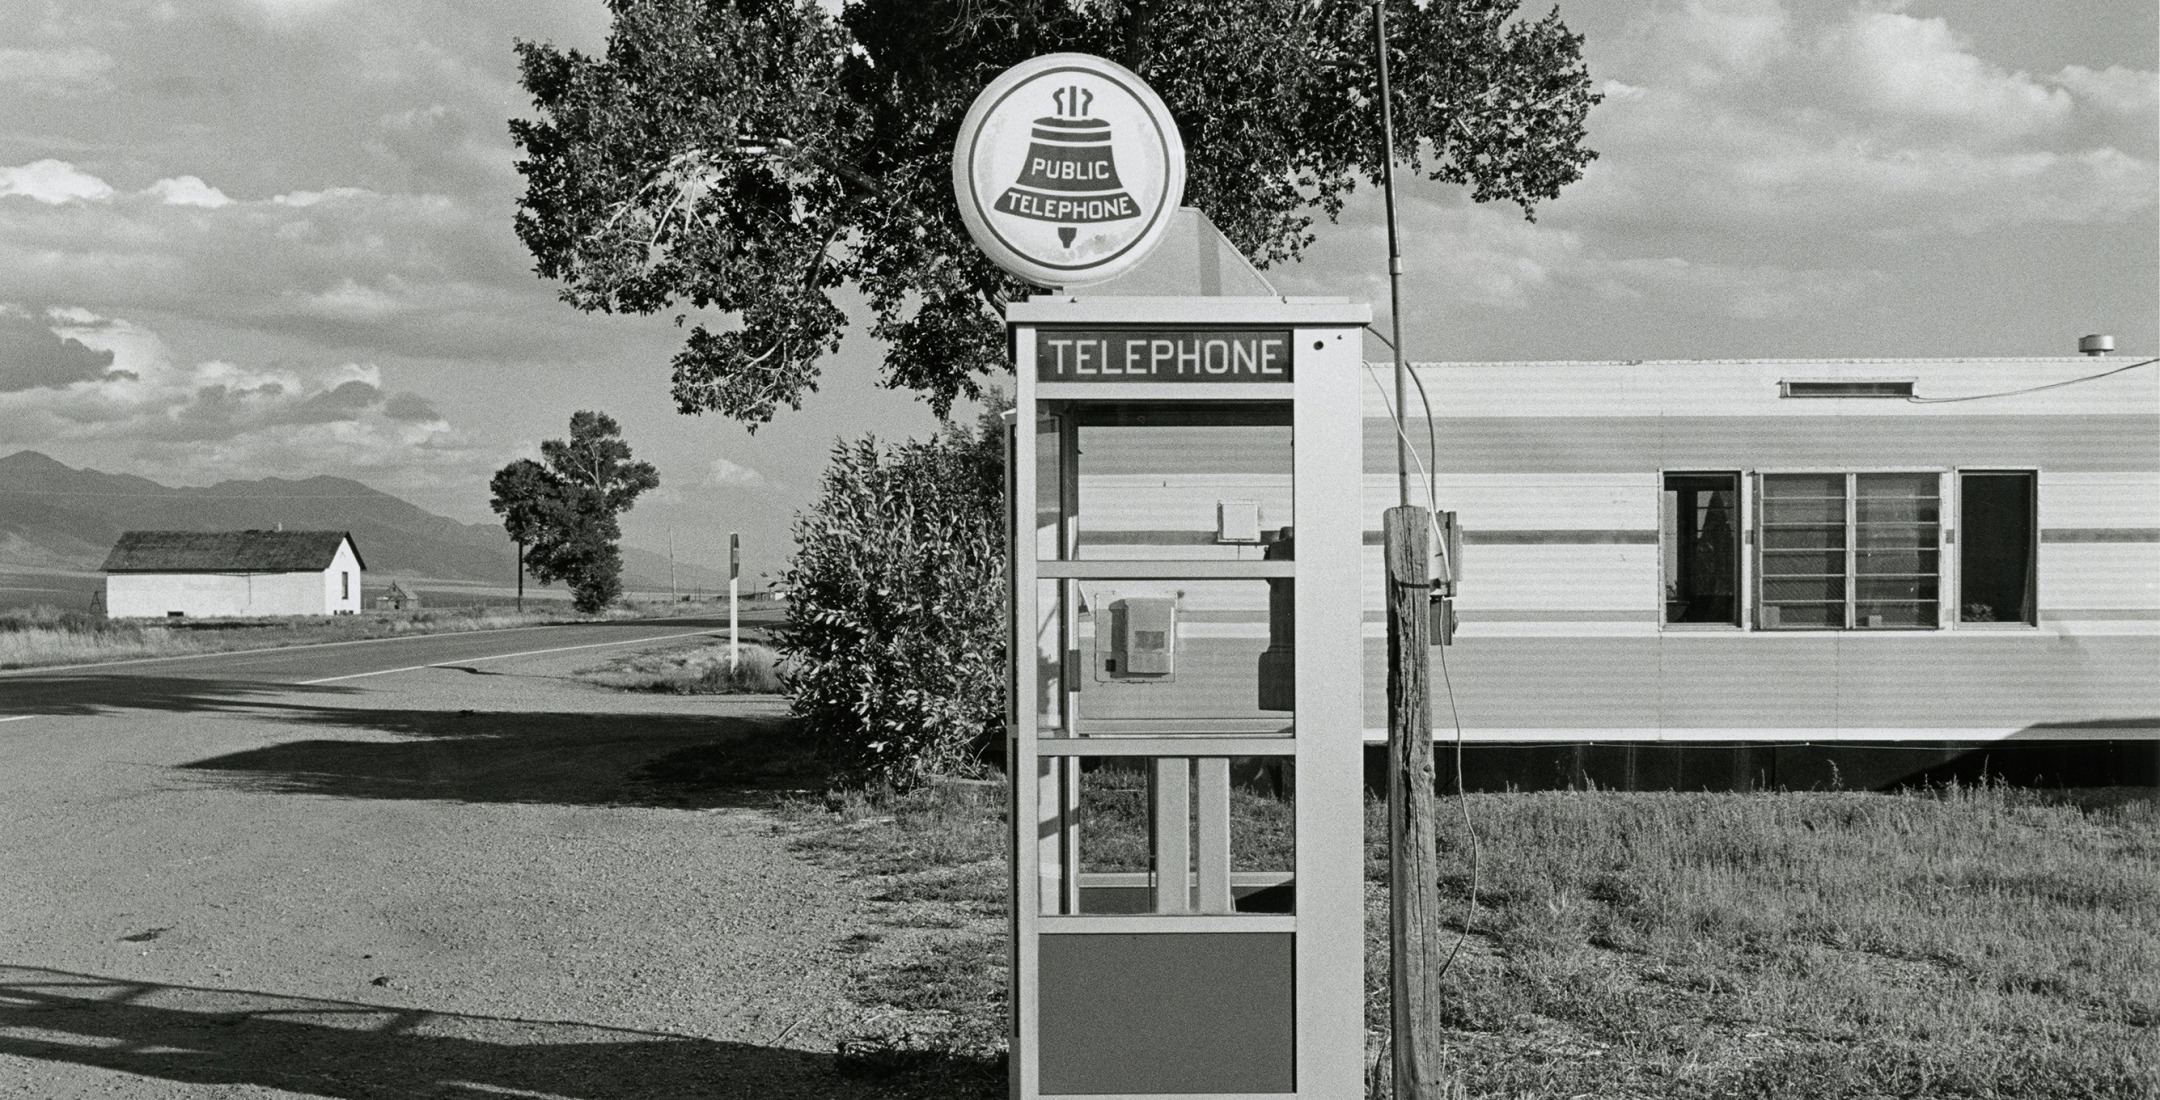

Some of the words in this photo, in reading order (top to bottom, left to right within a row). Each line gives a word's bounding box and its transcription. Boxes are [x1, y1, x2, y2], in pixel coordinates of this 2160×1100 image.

[1031, 158, 1109, 180] PUBLIC
[1008, 192, 1132, 219] TELEPHONE
[1048, 340, 1282, 374] TELEPHONE
